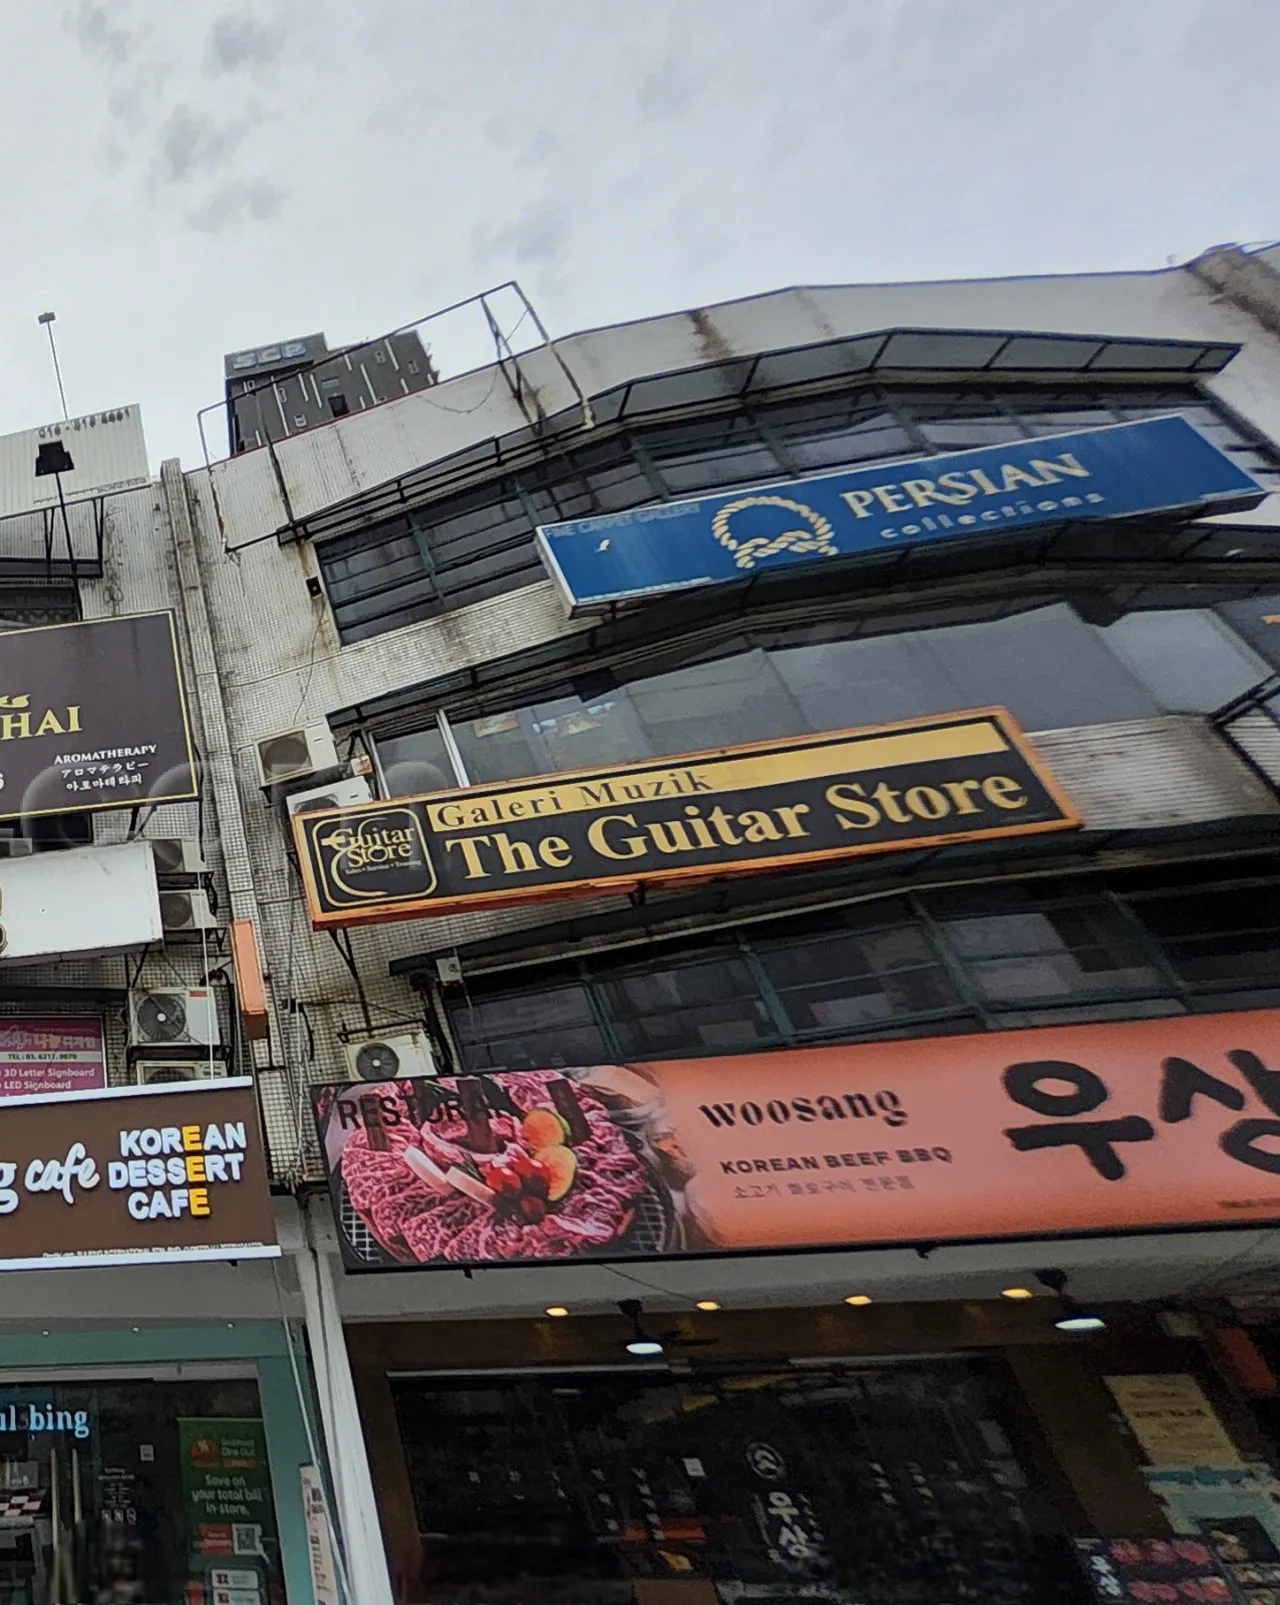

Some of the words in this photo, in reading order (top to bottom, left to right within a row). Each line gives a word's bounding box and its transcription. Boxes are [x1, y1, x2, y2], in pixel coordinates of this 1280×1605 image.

[838, 452, 1091, 521] PERSIAN
[878, 491, 1106, 539] collections
[53, 744, 158, 766] AROMATHERAPY
[435, 788, 562, 830] Galeri
[579, 767, 715, 809] Muzik
[321, 826, 416, 852] Guitar
[444, 830, 575, 882] The
[585, 800, 810, 861] Guitar
[832, 766, 1030, 834] Store
[346, 843, 414, 868] Store
[3, 1068, 17, 1077] 3D
[19, 1068, 46, 1077] Letter
[47, 1067, 95, 1079] Signboard
[3, 1081, 22, 1090] LED
[23, 1080, 72, 1092] Signboard
[698, 1084, 911, 1130] woosang
[119, 1121, 248, 1159] KOREAN
[108, 1149, 246, 1191] DESSERT
[719, 1155, 821, 1176] KOREAN
[822, 1150, 893, 1169] BEEF
[894, 1145, 954, 1164] BBQ
[127, 1186, 211, 1220] CAFE
[28, 1402, 91, 1439] bing
[190, 1489, 215, 1502] your
[217, 1487, 243, 1500] total
[244, 1487, 264, 1502] bill
[204, 1474, 231, 1487] Save
[232, 1475, 246, 1487] on
